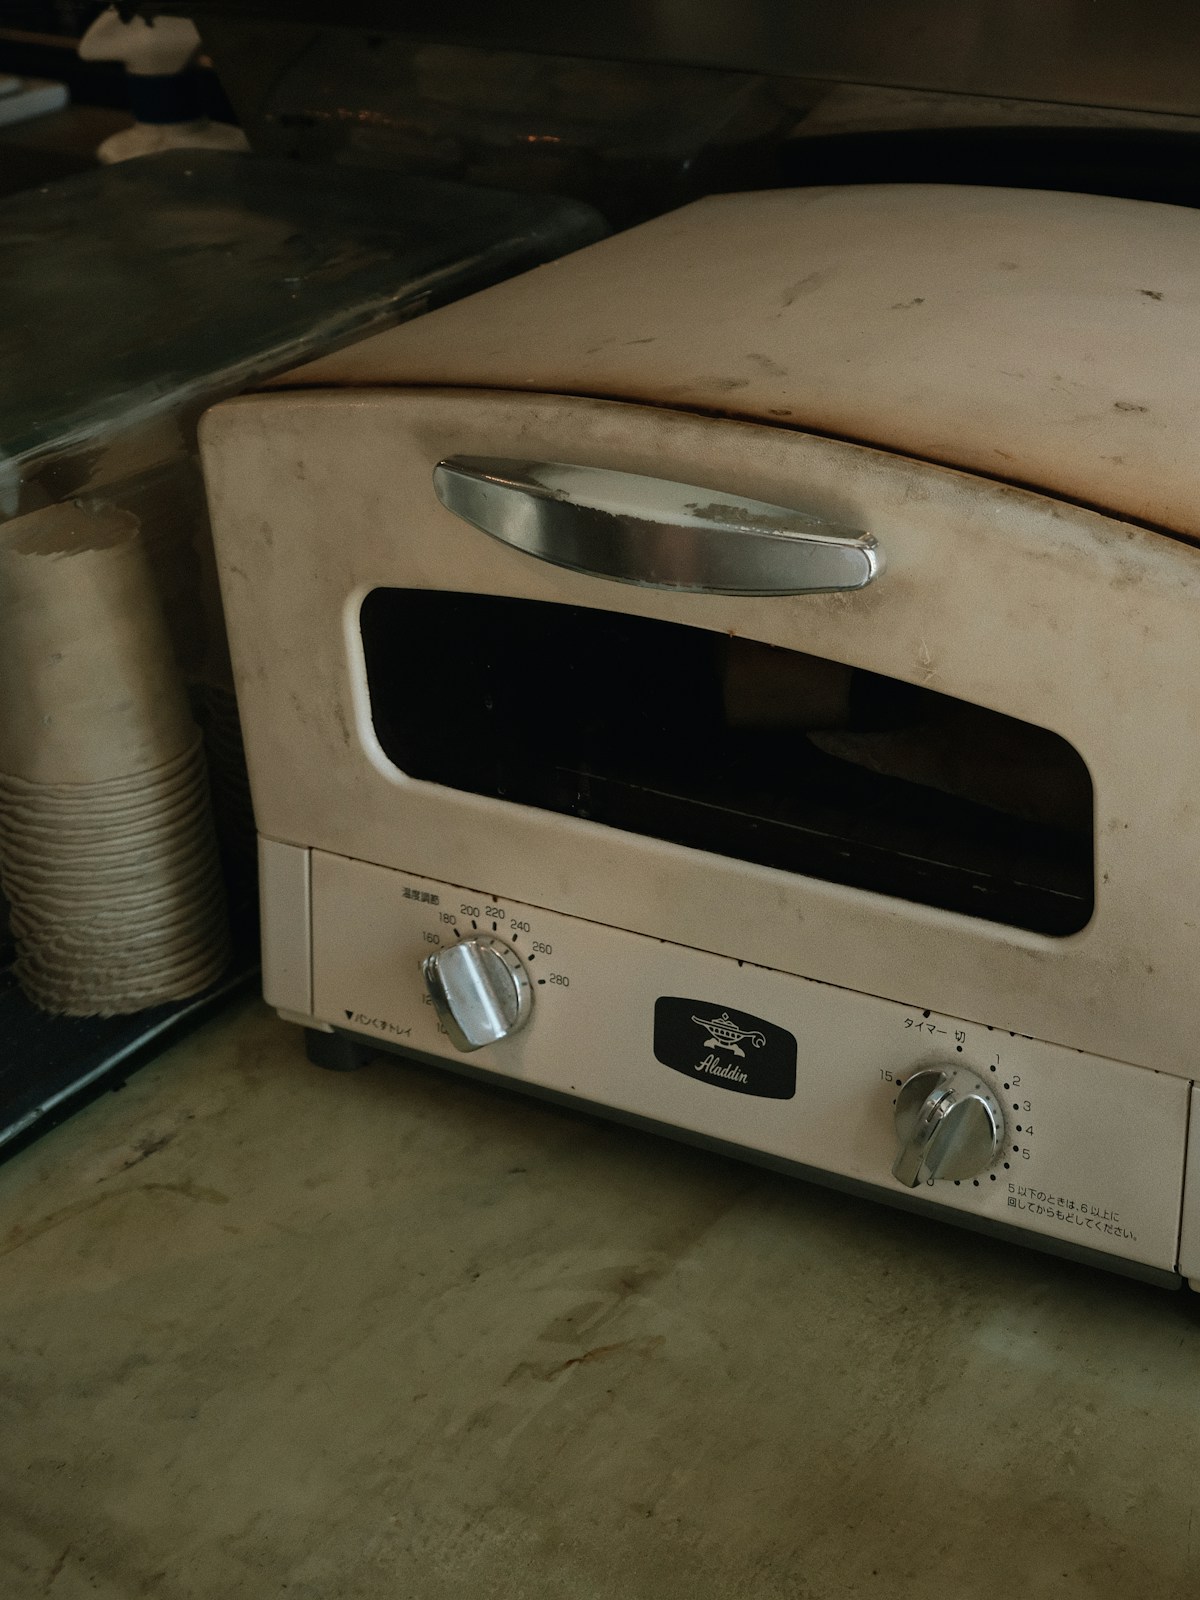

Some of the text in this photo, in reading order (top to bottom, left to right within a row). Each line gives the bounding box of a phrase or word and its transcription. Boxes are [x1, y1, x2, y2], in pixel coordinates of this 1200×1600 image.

[460, 904, 480, 918] 200
[485, 905, 505, 920] 220
[439, 912, 457, 926] 180
[510, 918, 531, 933] 240
[422, 930, 440, 945] 160
[532, 940, 553, 955] 260
[549, 972, 570, 987] 280
[903, 1017, 967, 1043] タイマー 切
[995, 1053, 1001, 1065] 1
[694, 1053, 749, 1085] Aladdin
[879, 1068, 893, 1082] 15
[1012, 1075, 1021, 1087] 2
[1022, 1100, 1032, 1112] 3
[1025, 1125, 1034, 1137] 4
[1022, 1148, 1031, 1160] 5
